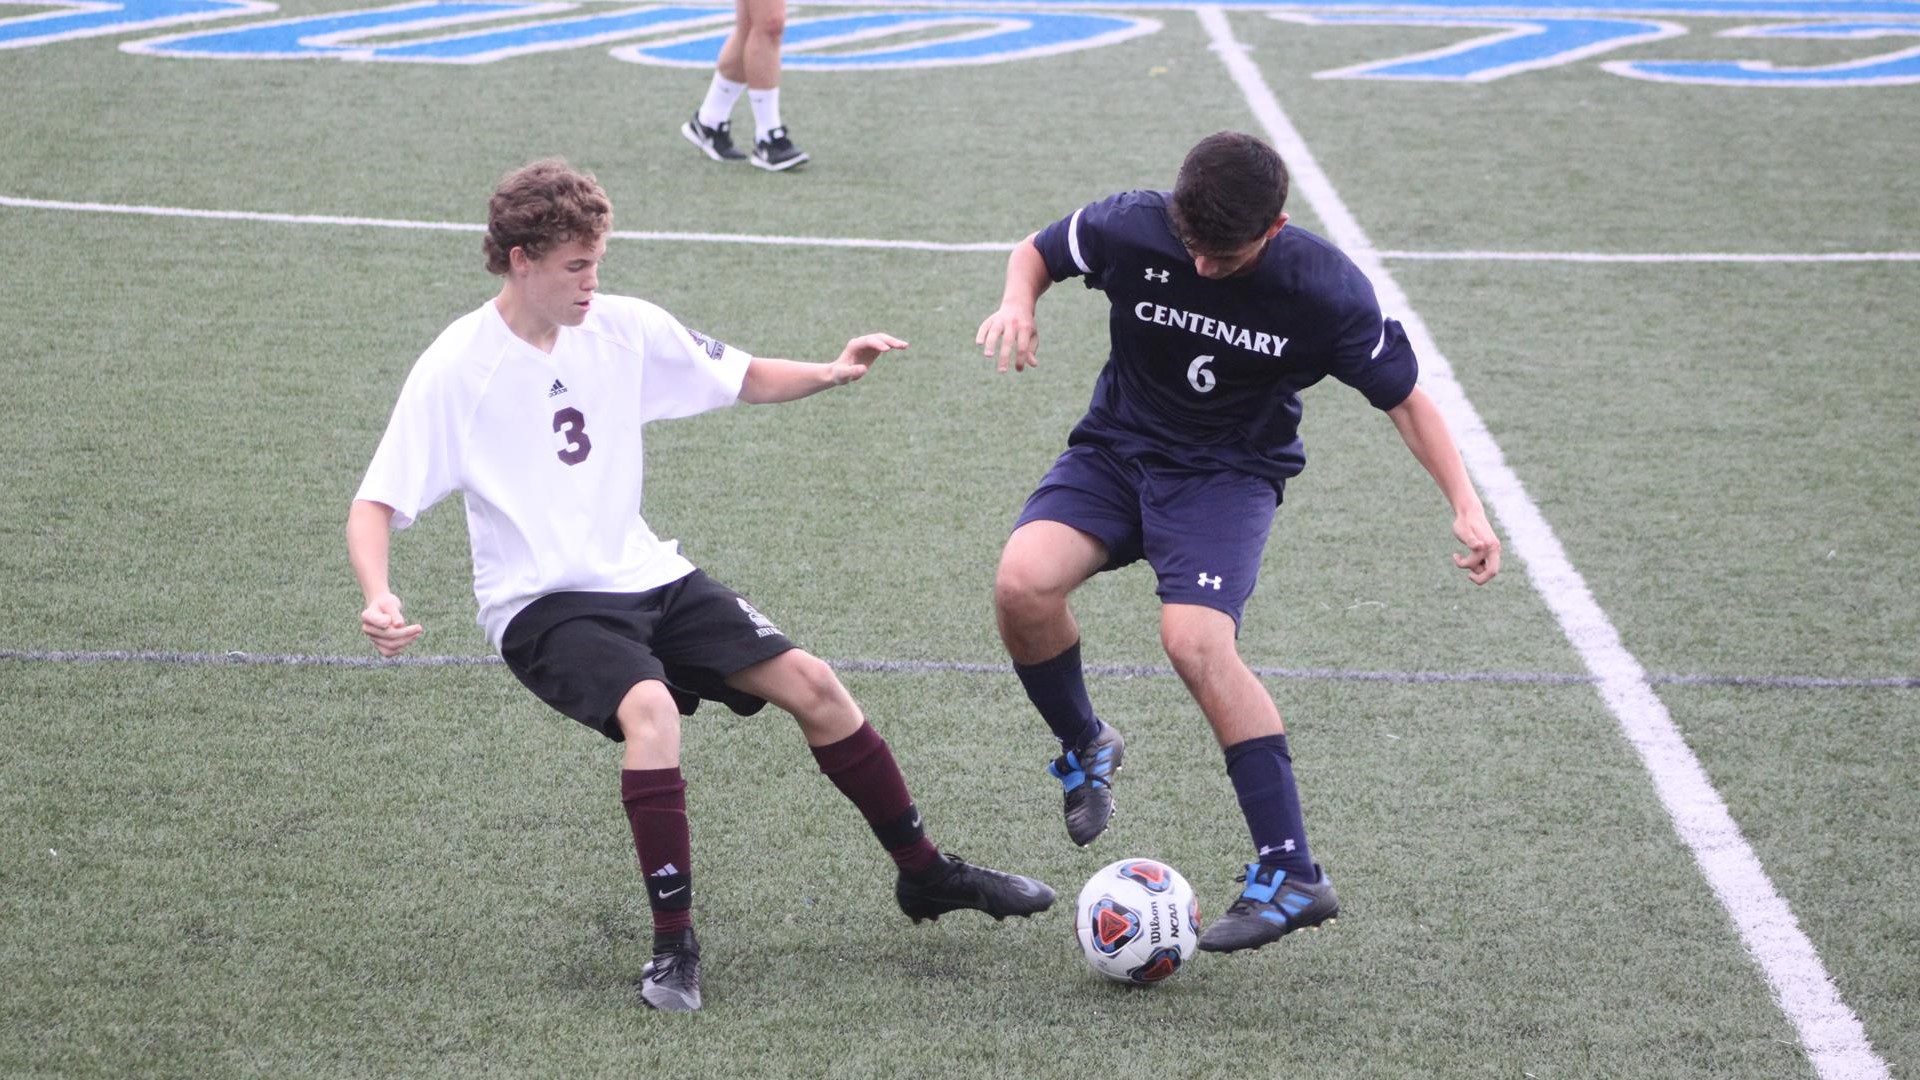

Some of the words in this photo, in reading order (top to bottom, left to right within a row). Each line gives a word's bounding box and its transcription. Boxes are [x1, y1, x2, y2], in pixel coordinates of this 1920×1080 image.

[1134, 301, 1289, 357] CENTENARY
[1187, 355, 1216, 393] 6
[552, 406, 592, 467] 3
[1150, 901, 1161, 945] Wilson
[1168, 903, 1179, 938] NCAA
